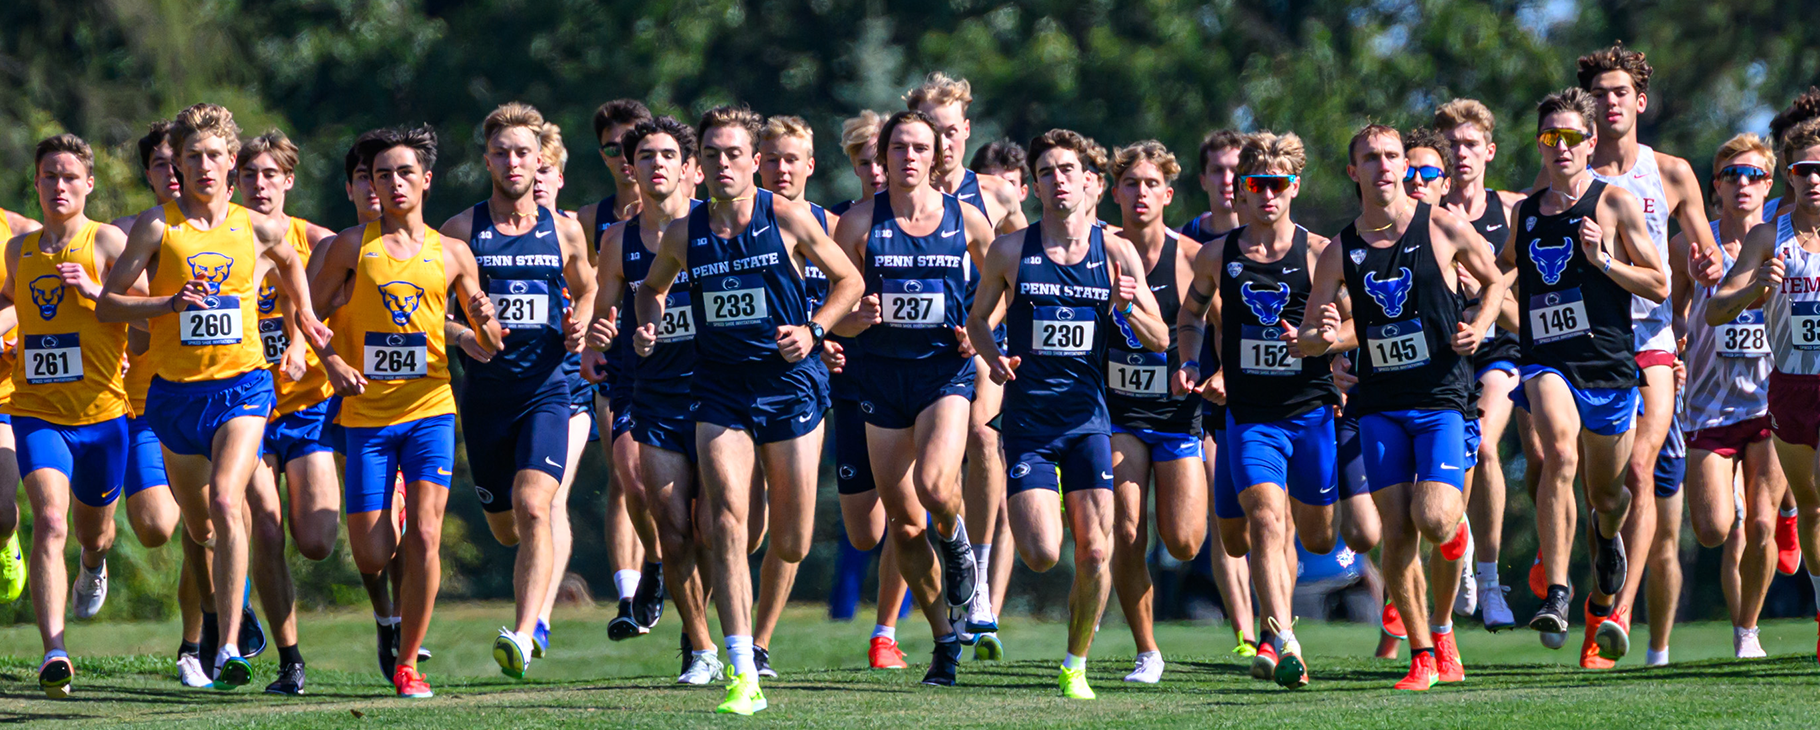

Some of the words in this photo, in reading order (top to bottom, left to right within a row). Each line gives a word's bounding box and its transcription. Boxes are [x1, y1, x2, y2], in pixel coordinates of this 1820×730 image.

[476, 255, 513, 267] PENN
[516, 254, 560, 267] STATE
[692, 260, 730, 279] PENN
[734, 252, 779, 271] STATE
[874, 255, 913, 267] PENN
[917, 255, 961, 268] STATE
[1020, 282, 1061, 296] PENN
[1064, 285, 1110, 300] STATE
[497, 298, 535, 321] 231
[713, 292, 755, 319] 233
[892, 297, 934, 321] 237
[190, 313, 232, 338] 260
[657, 310, 690, 336] 34
[1539, 307, 1578, 335] 146
[264, 334, 290, 357] 63
[1043, 324, 1085, 348] 230
[1725, 327, 1764, 350] 328
[374, 350, 416, 373] 264
[1252, 344, 1291, 367] 152
[1376, 337, 1418, 364] 145
[33, 352, 69, 377] 261
[1118, 368, 1156, 391] 147
